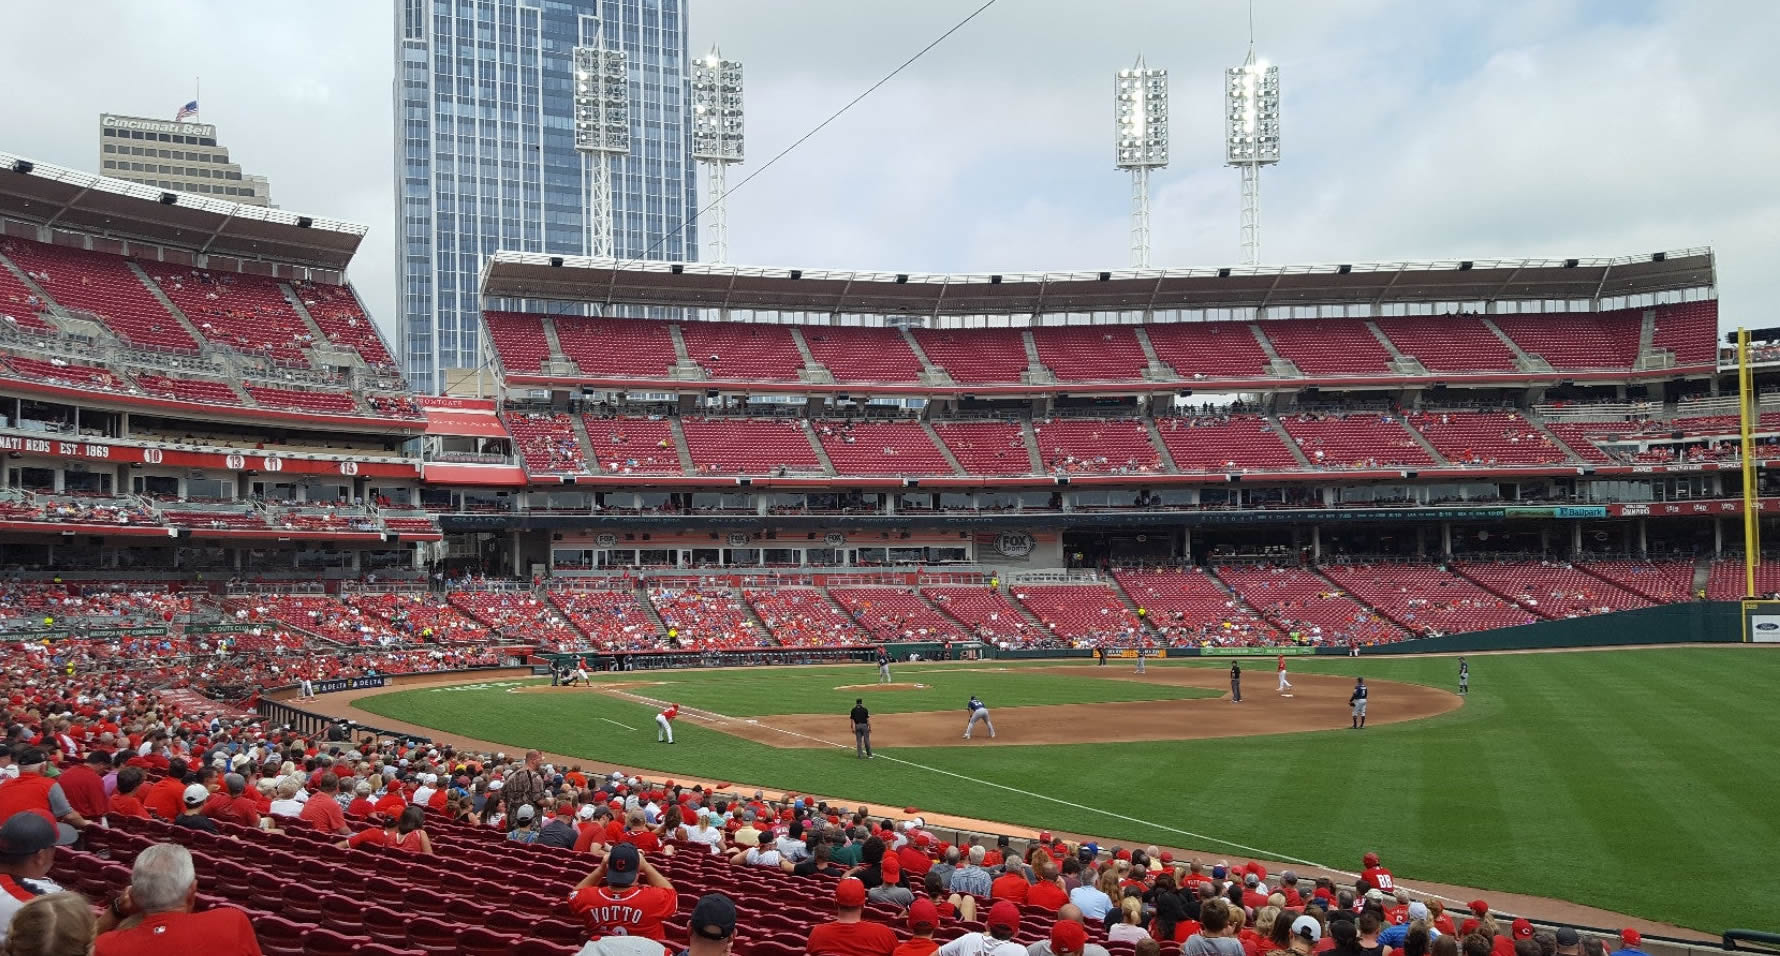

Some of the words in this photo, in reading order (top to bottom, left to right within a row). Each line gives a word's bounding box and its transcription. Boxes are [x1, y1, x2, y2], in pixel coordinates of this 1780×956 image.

[102, 116, 179, 133] Cincinnati
[182, 123, 213, 136] Bell
[26, 439, 51, 453] REDS
[60, 442, 83, 456] EST.
[85, 444, 109, 458] 1869
[229, 455, 241, 468] 13
[1569, 508, 1602, 517] Ballpark
[1003, 535, 1027, 546] FOX
[327, 682, 347, 690] DELTA
[590, 905, 643, 924] VOTTO
